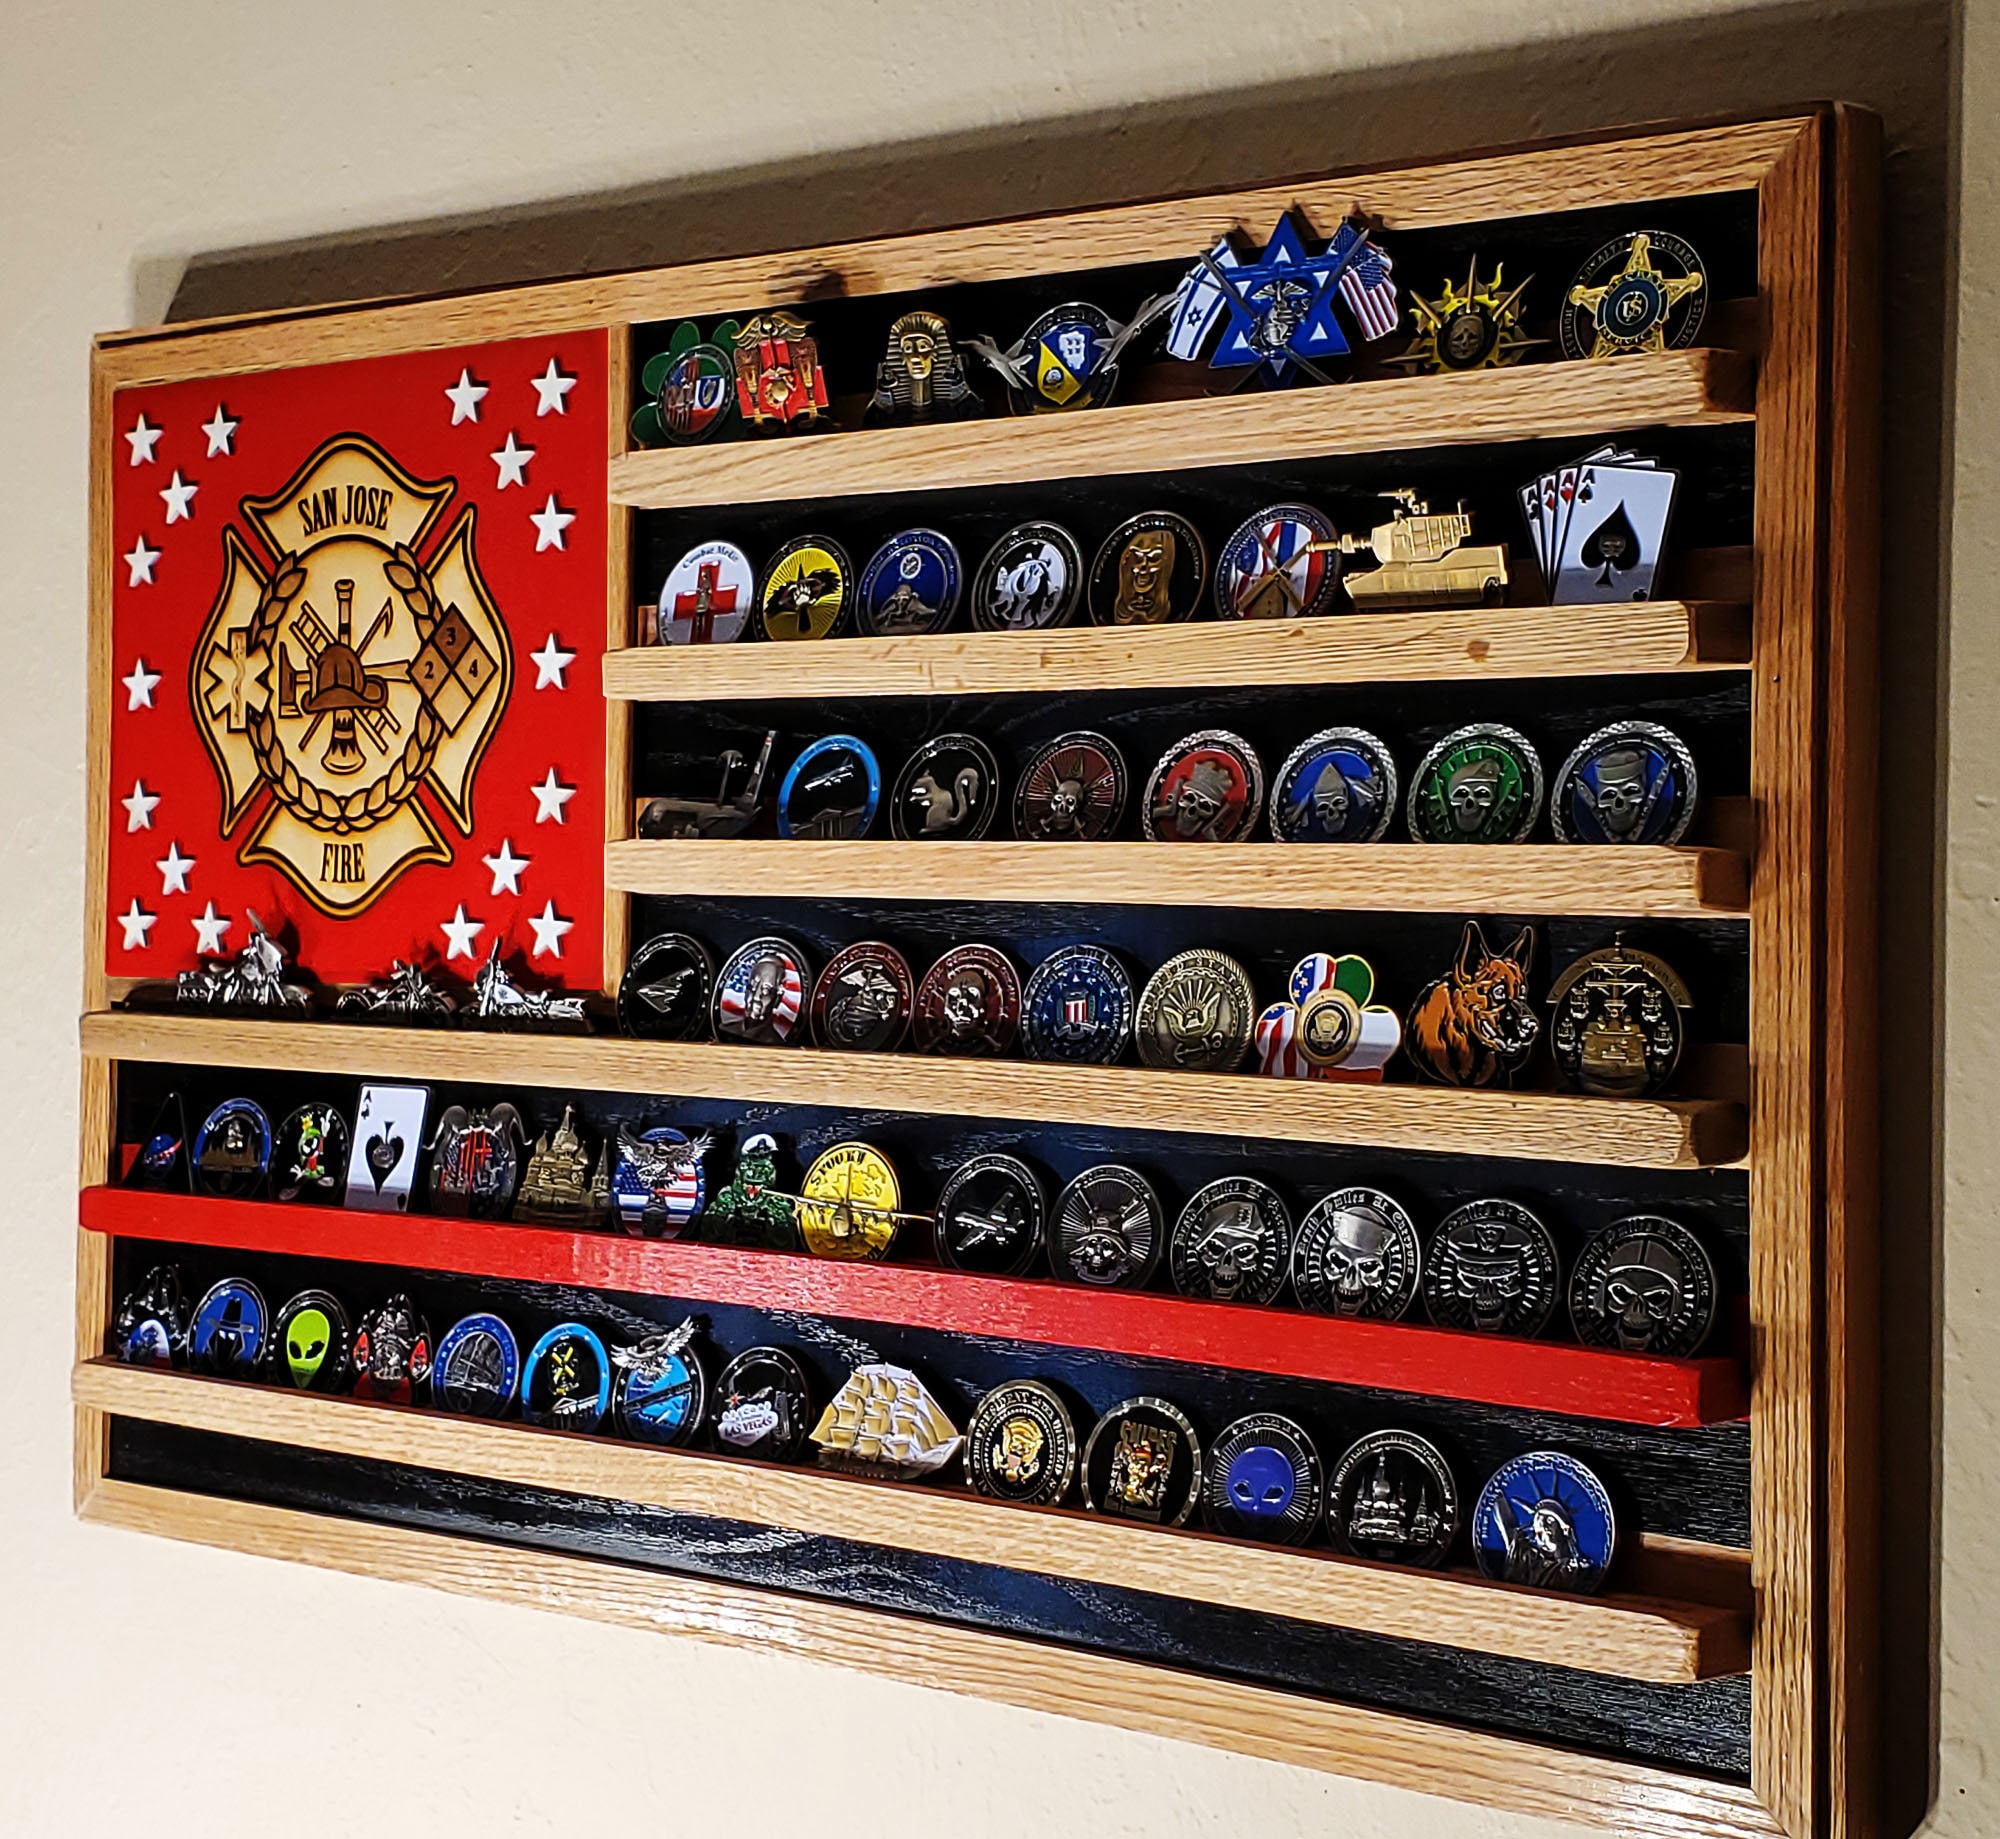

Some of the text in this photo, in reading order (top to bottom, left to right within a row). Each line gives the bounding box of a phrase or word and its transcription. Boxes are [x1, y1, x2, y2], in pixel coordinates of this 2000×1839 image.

[1654, 236, 1696, 269] COURAGE
[1561, 471, 1573, 487] A
[1582, 468, 1596, 484] A
[1527, 488, 1538, 505] A
[1543, 478, 1554, 495] A
[298, 485, 394, 537] SAN JOSE
[446, 626, 456, 646] 3
[424, 659, 479, 679] 2 4
[320, 843, 366, 883] FIRE
[1141, 960, 1184, 1029] UNITED
[1196, 957, 1247, 1009] STATES
[363, 1090, 372, 1103] A
[724, 1422, 741, 1437] LAS
[742, 1415, 773, 1433] VEGAS
